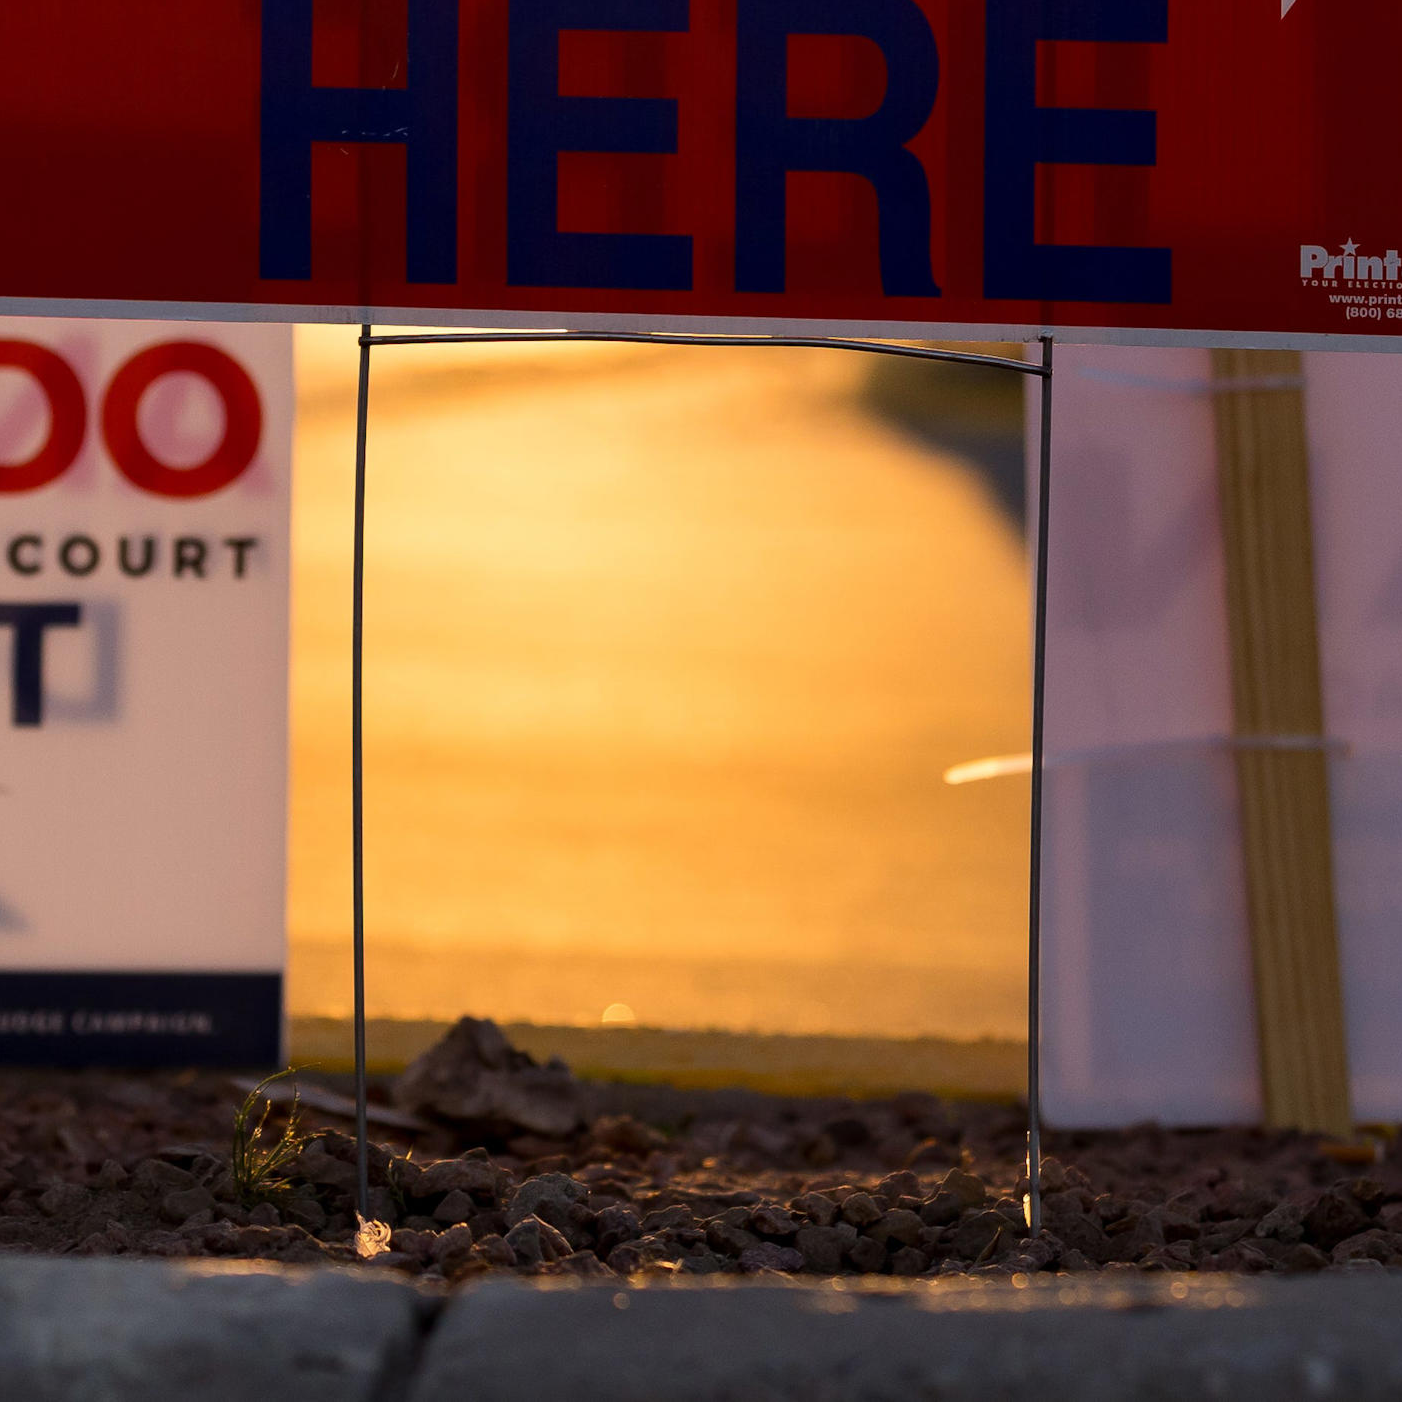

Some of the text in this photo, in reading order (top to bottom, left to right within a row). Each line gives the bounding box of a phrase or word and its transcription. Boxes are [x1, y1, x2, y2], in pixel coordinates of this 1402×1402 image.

[1301, 280, 1338, 288] YOUR
[1345, 306, 1381, 320] (800)
[7, 531, 260, 579] COURT
